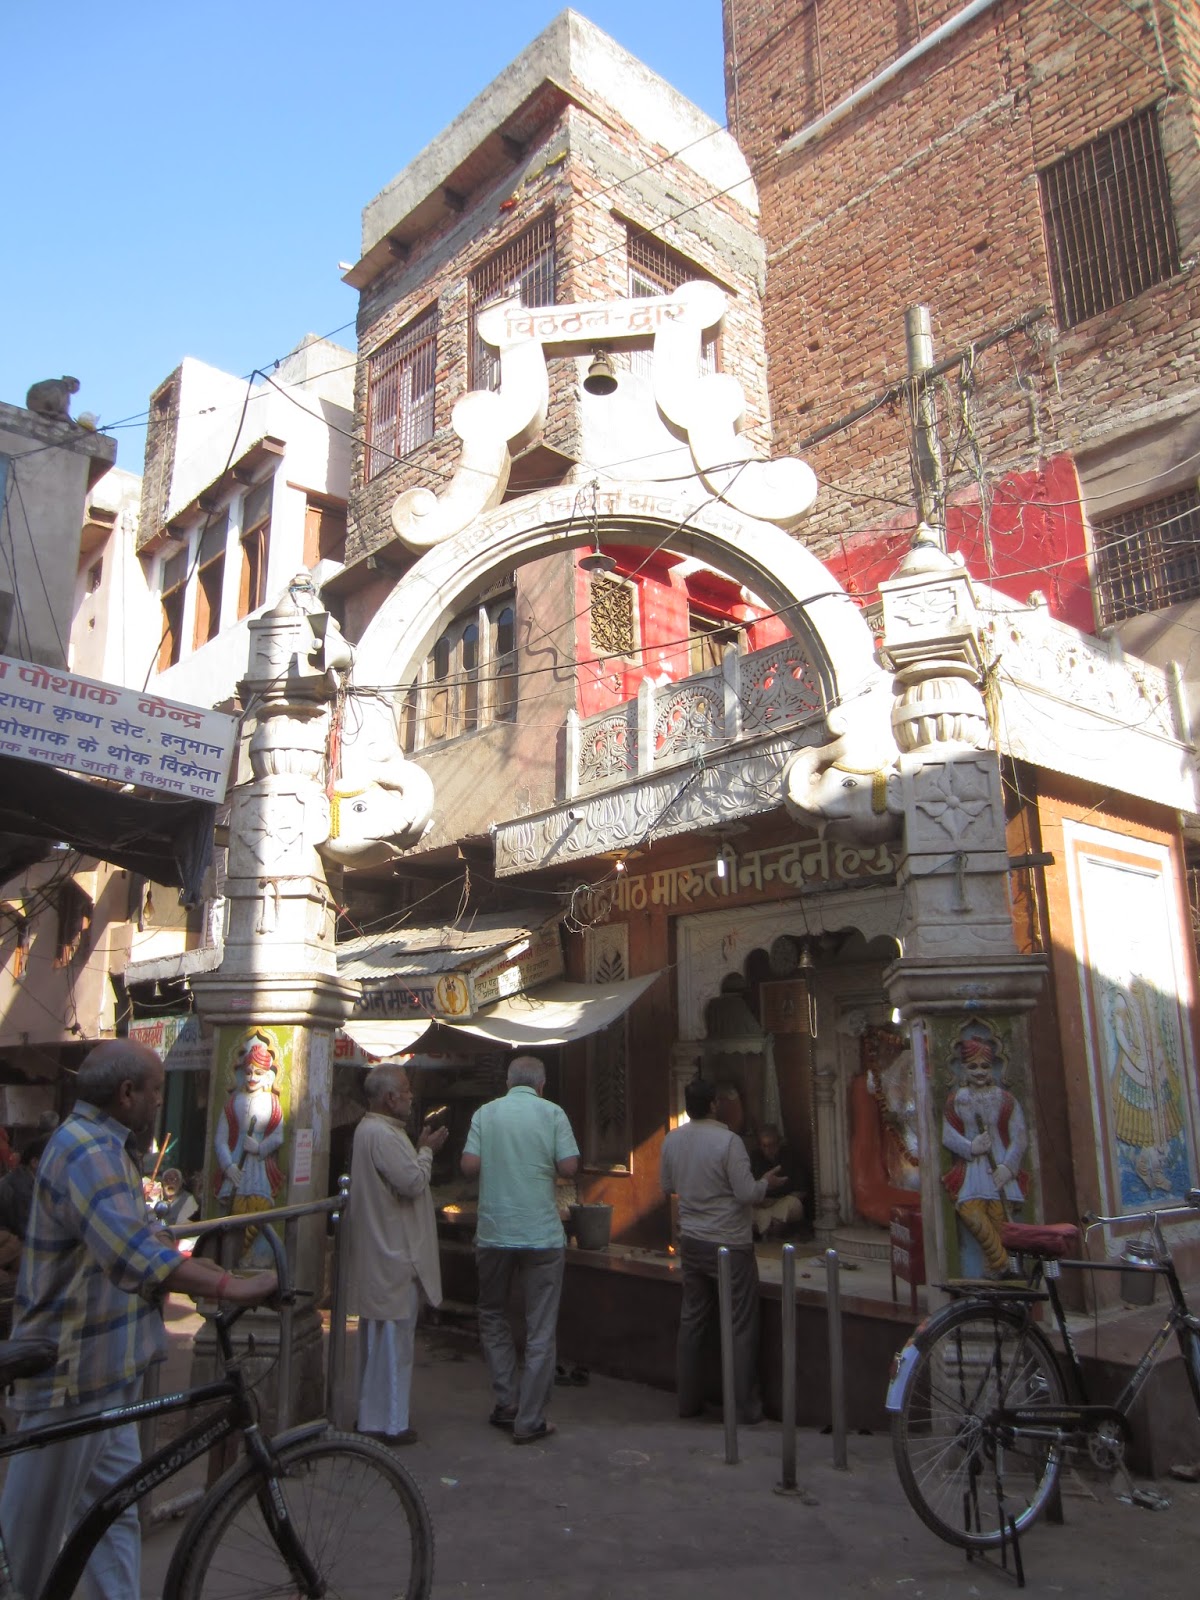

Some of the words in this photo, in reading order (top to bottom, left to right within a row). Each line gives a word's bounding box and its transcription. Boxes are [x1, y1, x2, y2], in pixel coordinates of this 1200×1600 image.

[0, 692, 46, 715] राधा
[53, 705, 104, 729] कृष्ण
[161, 732, 224, 759] हनुमान
[18, 665, 122, 706] पोशाक
[138, 696, 205, 729] केन्द्र
[0, 716, 70, 746] पोशाक
[77, 736, 100, 753] के
[107, 744, 152, 766] थोक
[159, 754, 222, 784] विक्रेता
[140, 771, 185, 791] विश्राम
[190, 784, 216, 798] घाट
